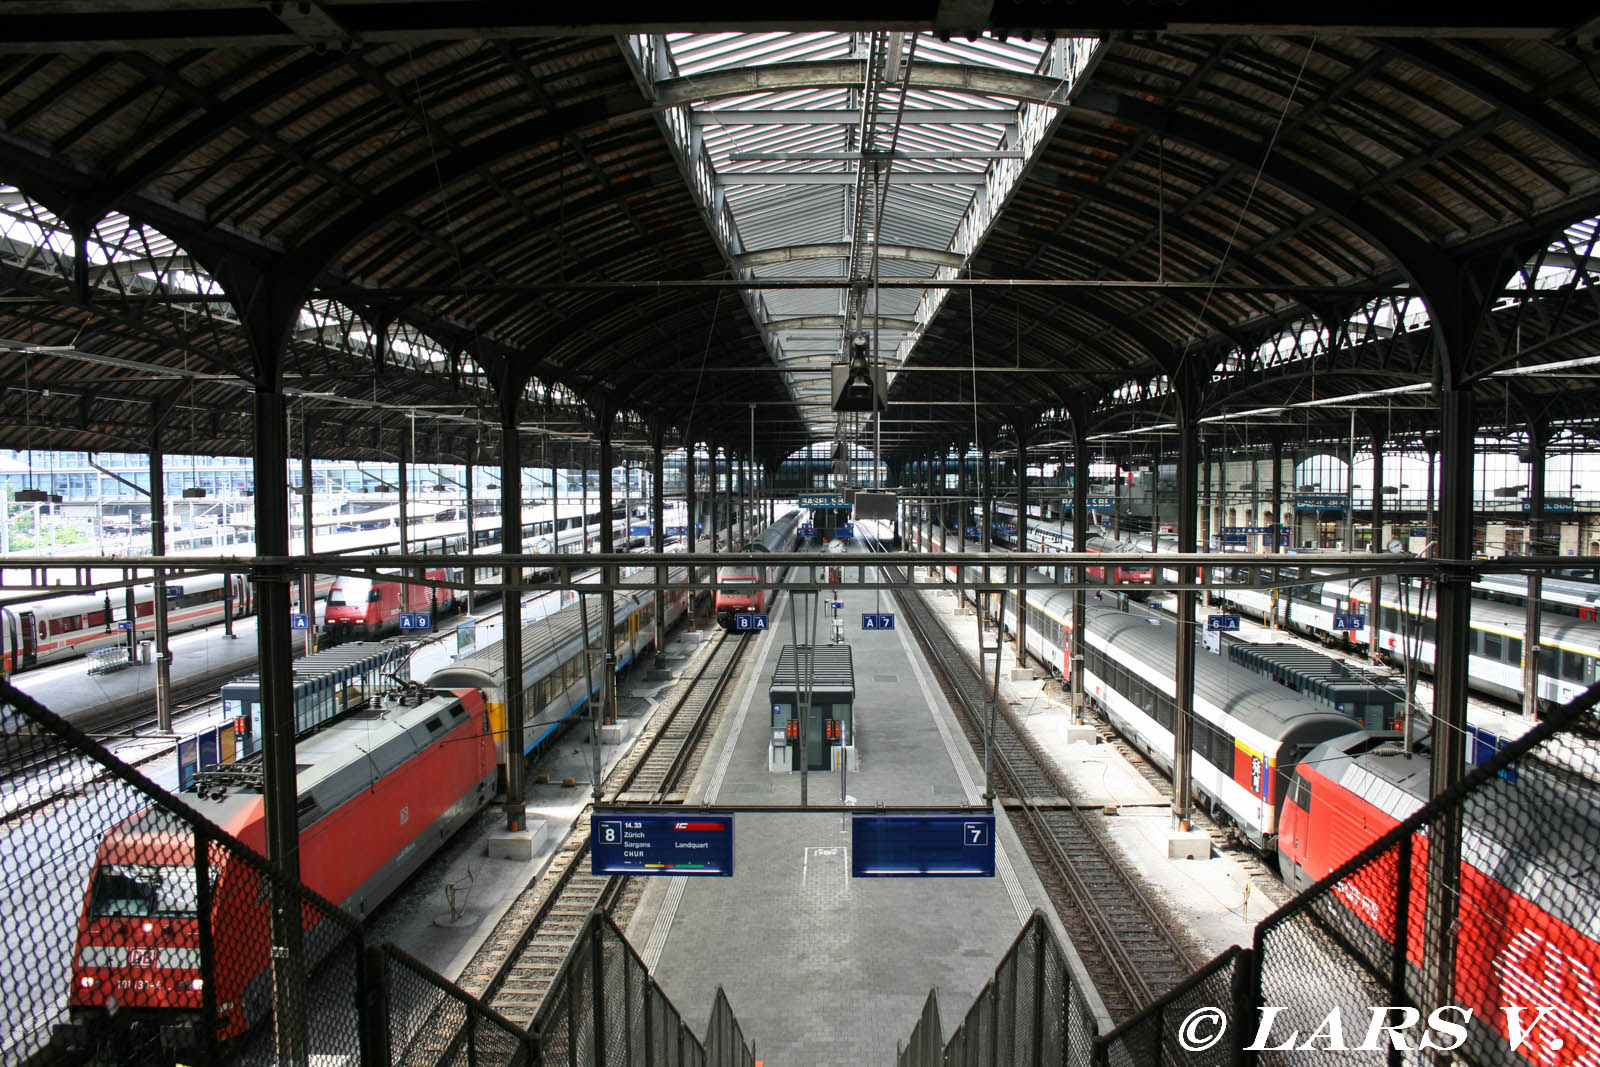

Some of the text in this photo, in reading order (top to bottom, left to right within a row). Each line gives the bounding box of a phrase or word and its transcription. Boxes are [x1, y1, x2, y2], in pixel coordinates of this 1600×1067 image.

[298, 618, 304, 626] A
[404, 618, 426, 627] A 9
[741, 619, 765, 627] 8 A
[867, 619, 890, 627] A 7
[1213, 619, 1236, 628] 6 A
[1338, 619, 1360, 628] A 5
[605, 828, 615, 842] 8
[971, 829, 981, 843] 7
[624, 841, 651, 849] Sargans
[675, 841, 709, 849] Landquart
